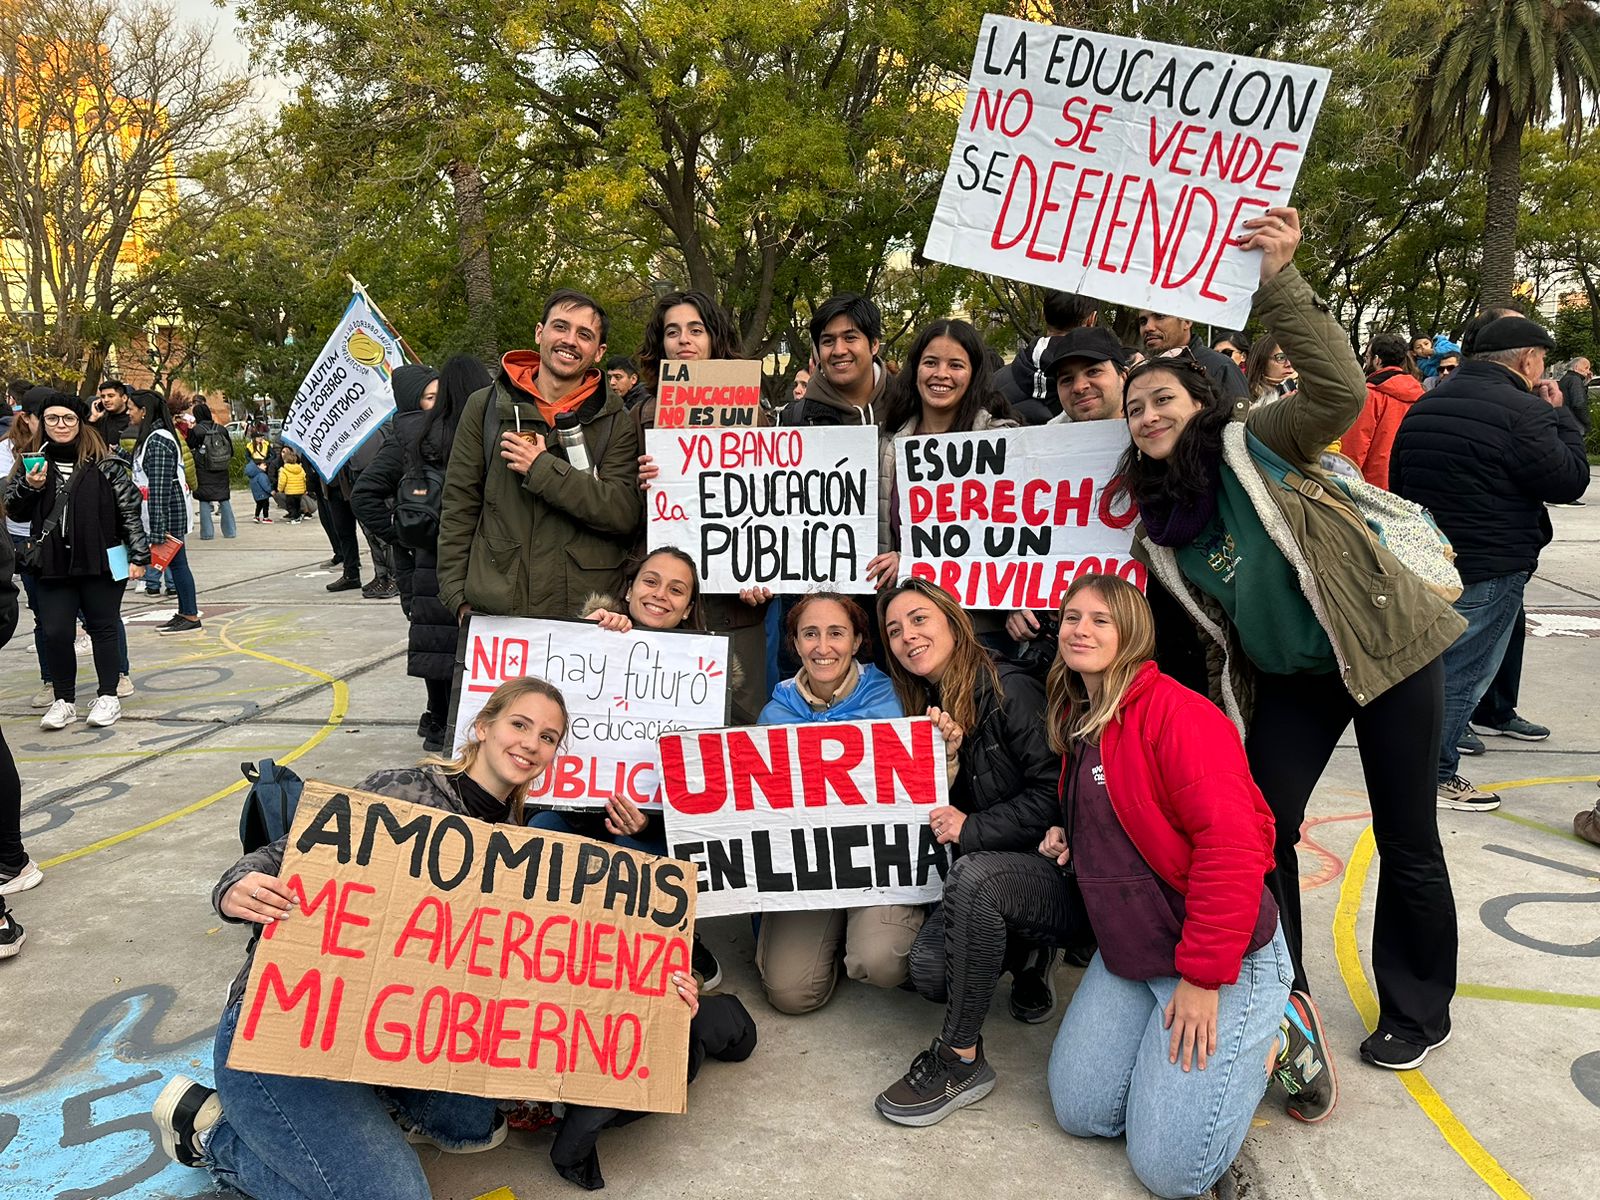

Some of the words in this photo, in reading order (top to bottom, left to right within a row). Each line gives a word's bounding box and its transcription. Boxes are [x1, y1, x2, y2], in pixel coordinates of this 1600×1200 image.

[983, 25, 1027, 80] LA
[970, 87, 1034, 138] NO
[1054, 96, 1113, 154] SE
[1148, 115, 1300, 191] VENDE
[957, 144, 1009, 195] SE
[990, 153, 1270, 302] DEFIENDE
[660, 385, 760, 406] EDUCACION
[662, 363, 689, 382] LA
[658, 406, 685, 426] NO
[688, 406, 715, 426] ES
[720, 407, 754, 426] UN
[678, 434, 713, 475] YO
[720, 429, 803, 469] BANCO
[651, 490, 690, 522] la
[698, 456, 868, 519] EDUCACIÓN
[908, 477, 1140, 529] DERECHO
[911, 524, 971, 558] NO
[983, 525, 1052, 557] UN
[471, 635, 529, 681] NO
[545, 632, 607, 701] hay
[624, 641, 708, 708] futuro
[659, 720, 937, 815] UNRN
[296, 793, 473, 892] AMO
[480, 830, 564, 902] MI
[673, 838, 747, 893] EN
[751, 823, 950, 893] LUCHA
[263, 873, 376, 959] ME
[242, 962, 344, 1052] MI
[364, 983, 651, 1081] GOBIERNO.
